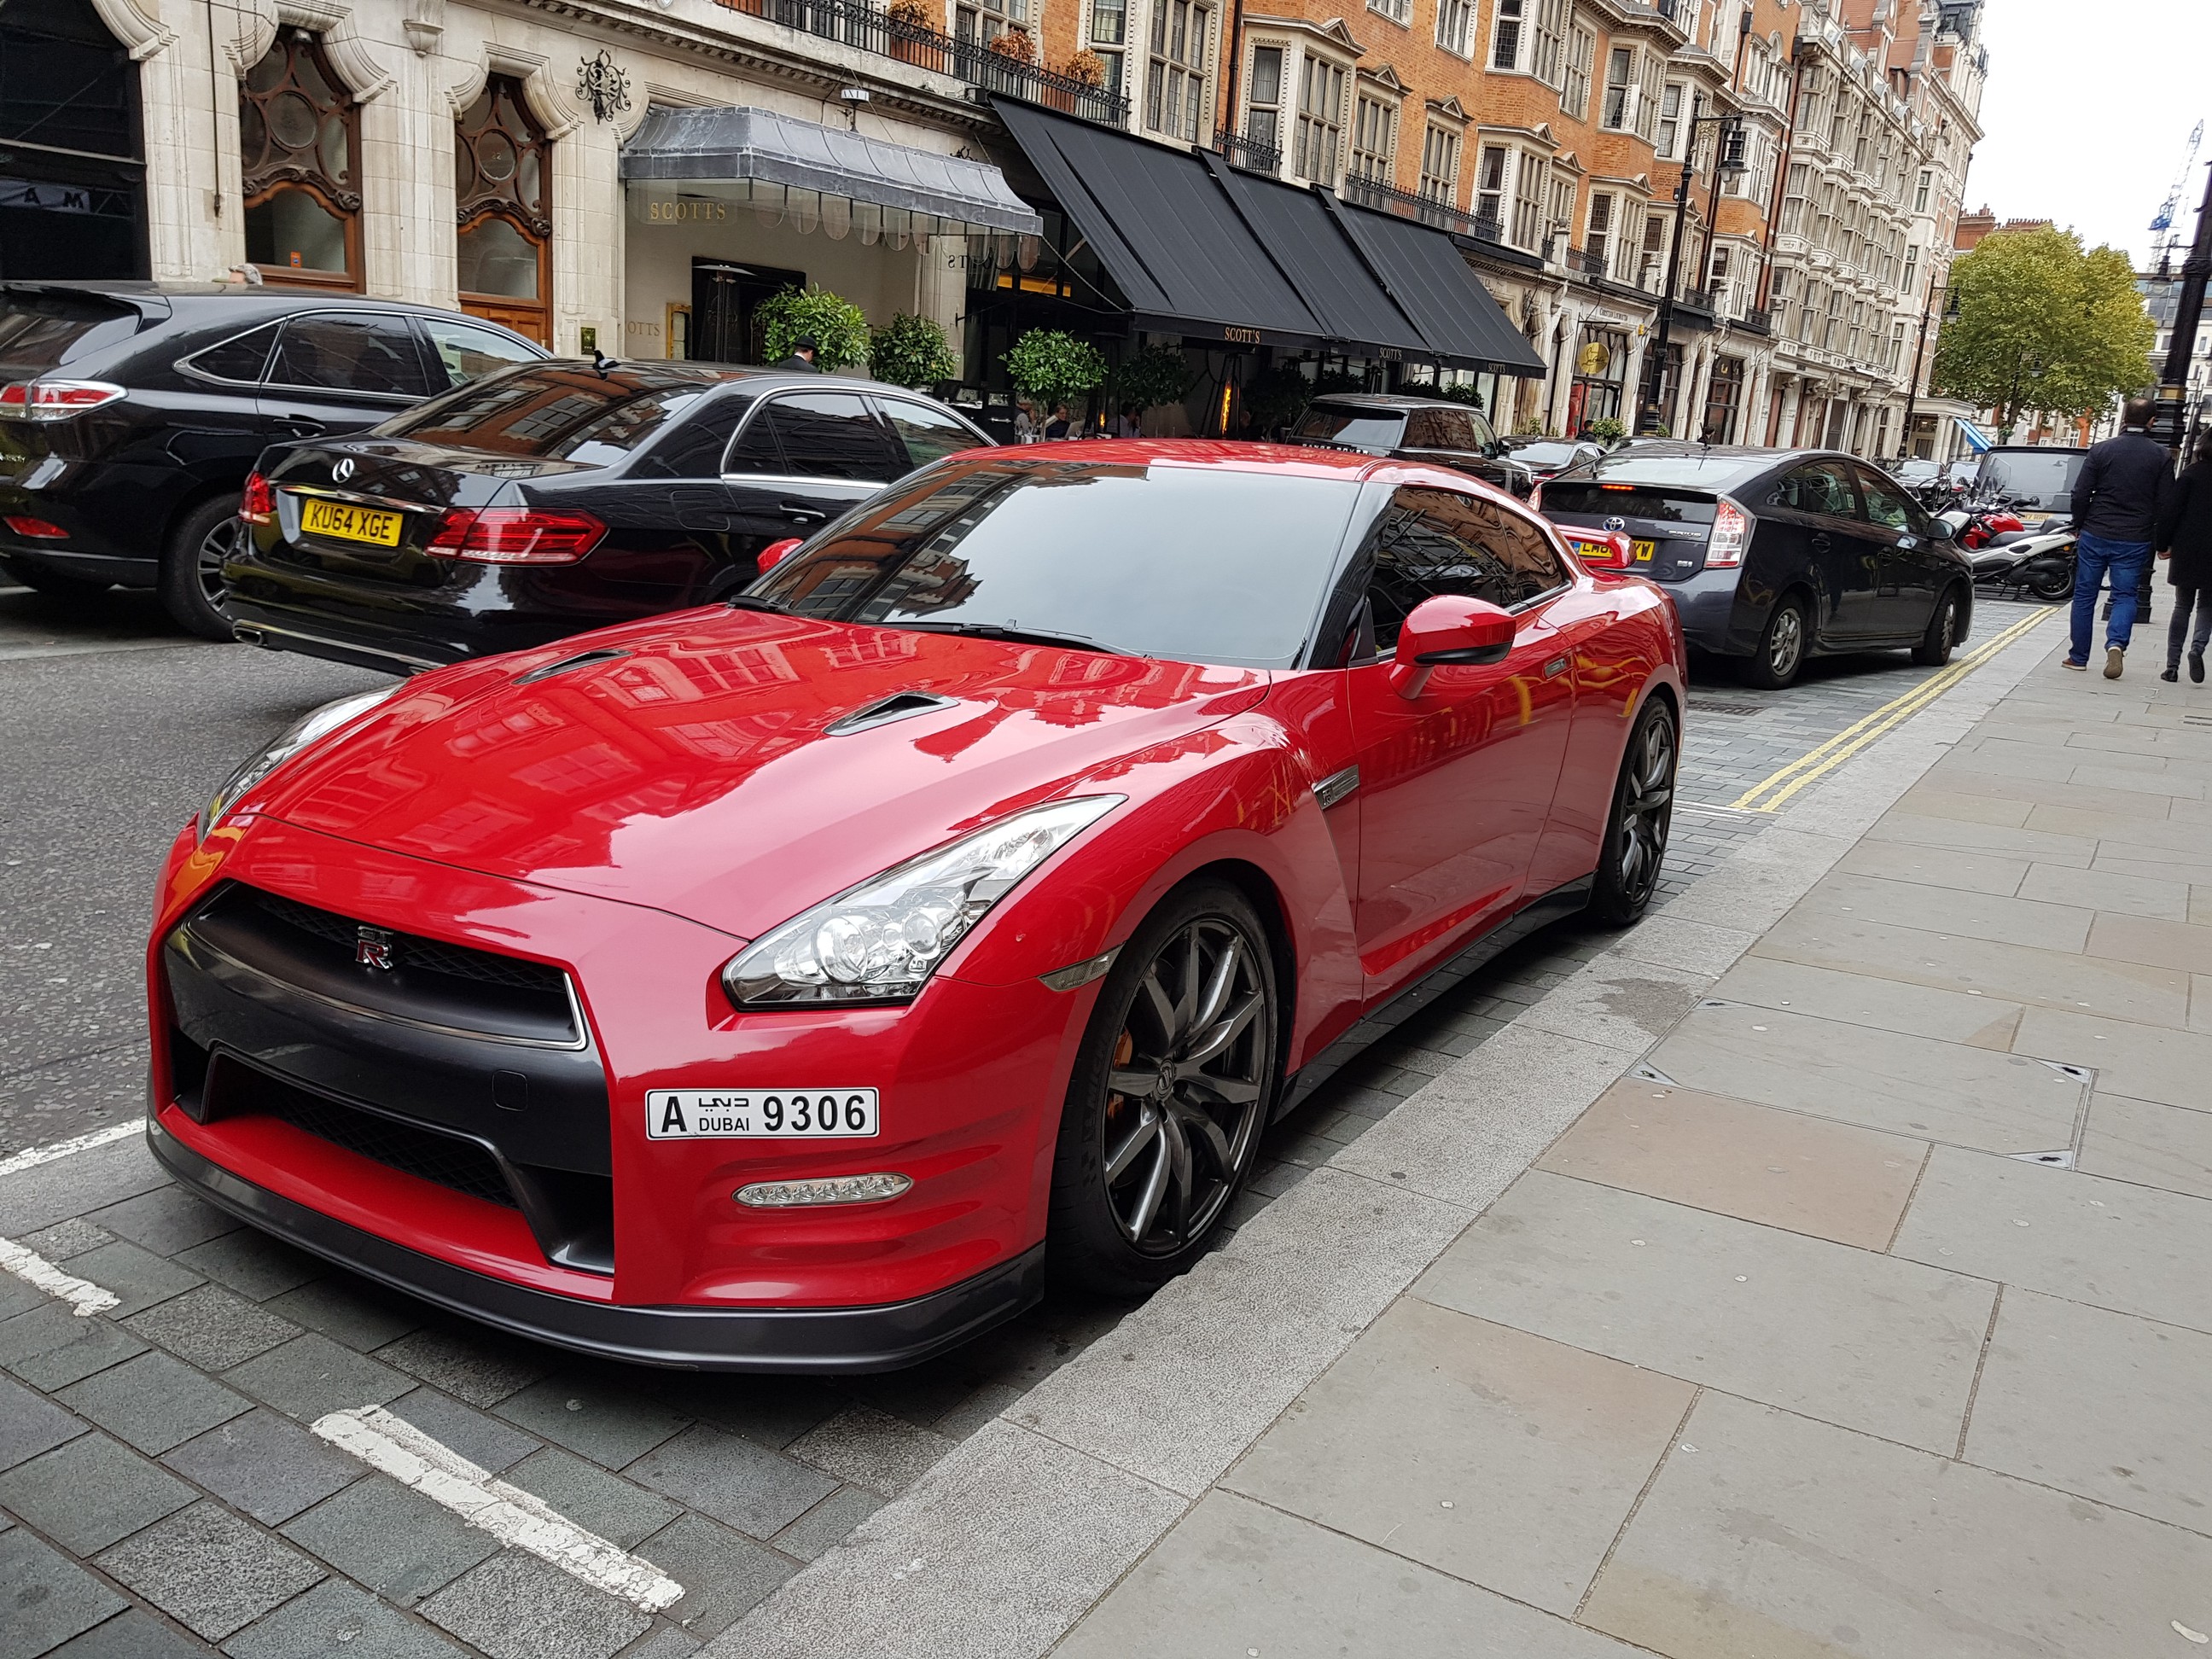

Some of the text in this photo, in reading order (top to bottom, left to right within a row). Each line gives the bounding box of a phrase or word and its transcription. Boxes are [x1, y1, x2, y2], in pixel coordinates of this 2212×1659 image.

[650, 202, 725, 220] SCOTTS
[1225, 327, 1260, 344] SCOTT'S
[310, 504, 394, 539] KU64 XGE
[698, 1097, 749, 1112] دبي
[661, 1095, 866, 1133] A DUBAI 9306
